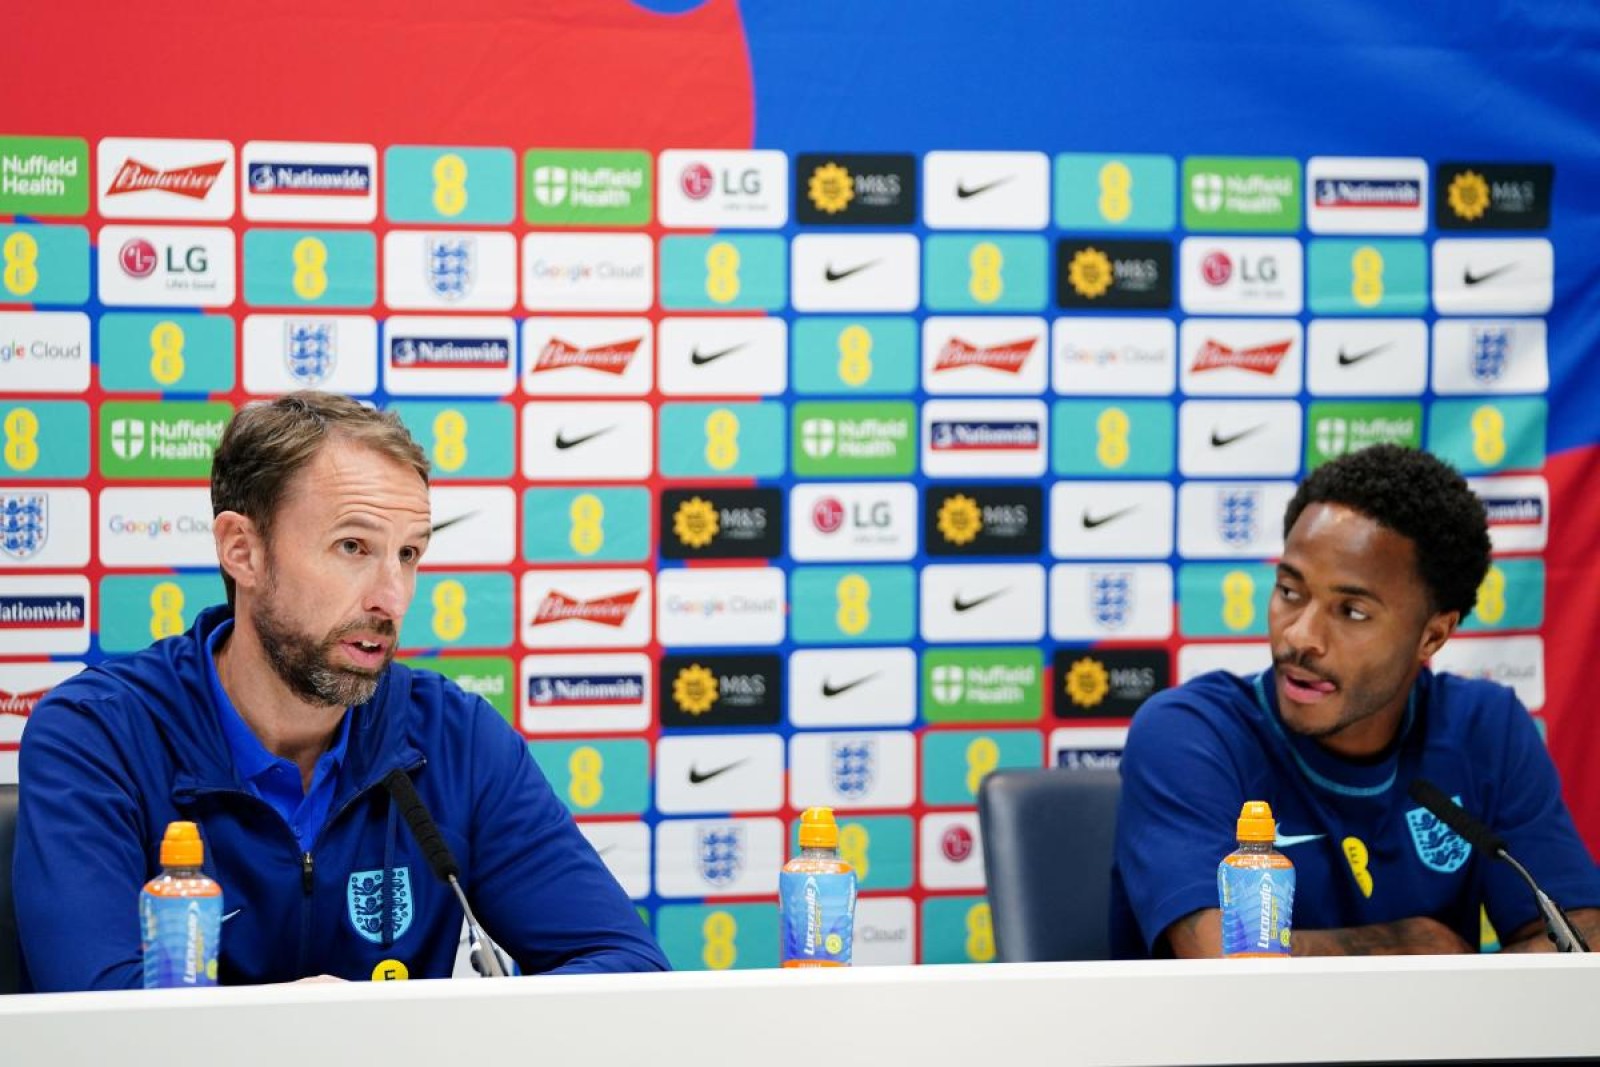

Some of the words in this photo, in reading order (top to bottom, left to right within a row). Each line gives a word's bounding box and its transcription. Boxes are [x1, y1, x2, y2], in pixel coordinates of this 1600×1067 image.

[2, 154, 77, 176] Nuffield
[2, 174, 65, 196] Health
[116, 164, 218, 189] Budweiser
[277, 168, 369, 188] Nationwide
[570, 167, 643, 188] Nuffield
[722, 169, 762, 195] LG
[855, 174, 901, 194] M&S
[570, 187, 631, 207] Health
[166, 245, 208, 273] LG
[1240, 257, 1279, 283] LG
[31, 340, 81, 359] Cloud
[418, 342, 508, 363] Nationwide
[838, 418, 908, 440] Nuffield
[151, 438, 212, 459] Health
[838, 438, 897, 459] Health
[720, 508, 767, 530] M&S
[853, 501, 892, 528] LG
[983, 505, 1029, 525] M&S
[109, 515, 171, 538] Google
[0, 601, 80, 621] ationwide
[551, 677, 642, 699] Nationwide
[719, 675, 766, 696] M&S
[1257, 882, 1272, 949] Lucozade
